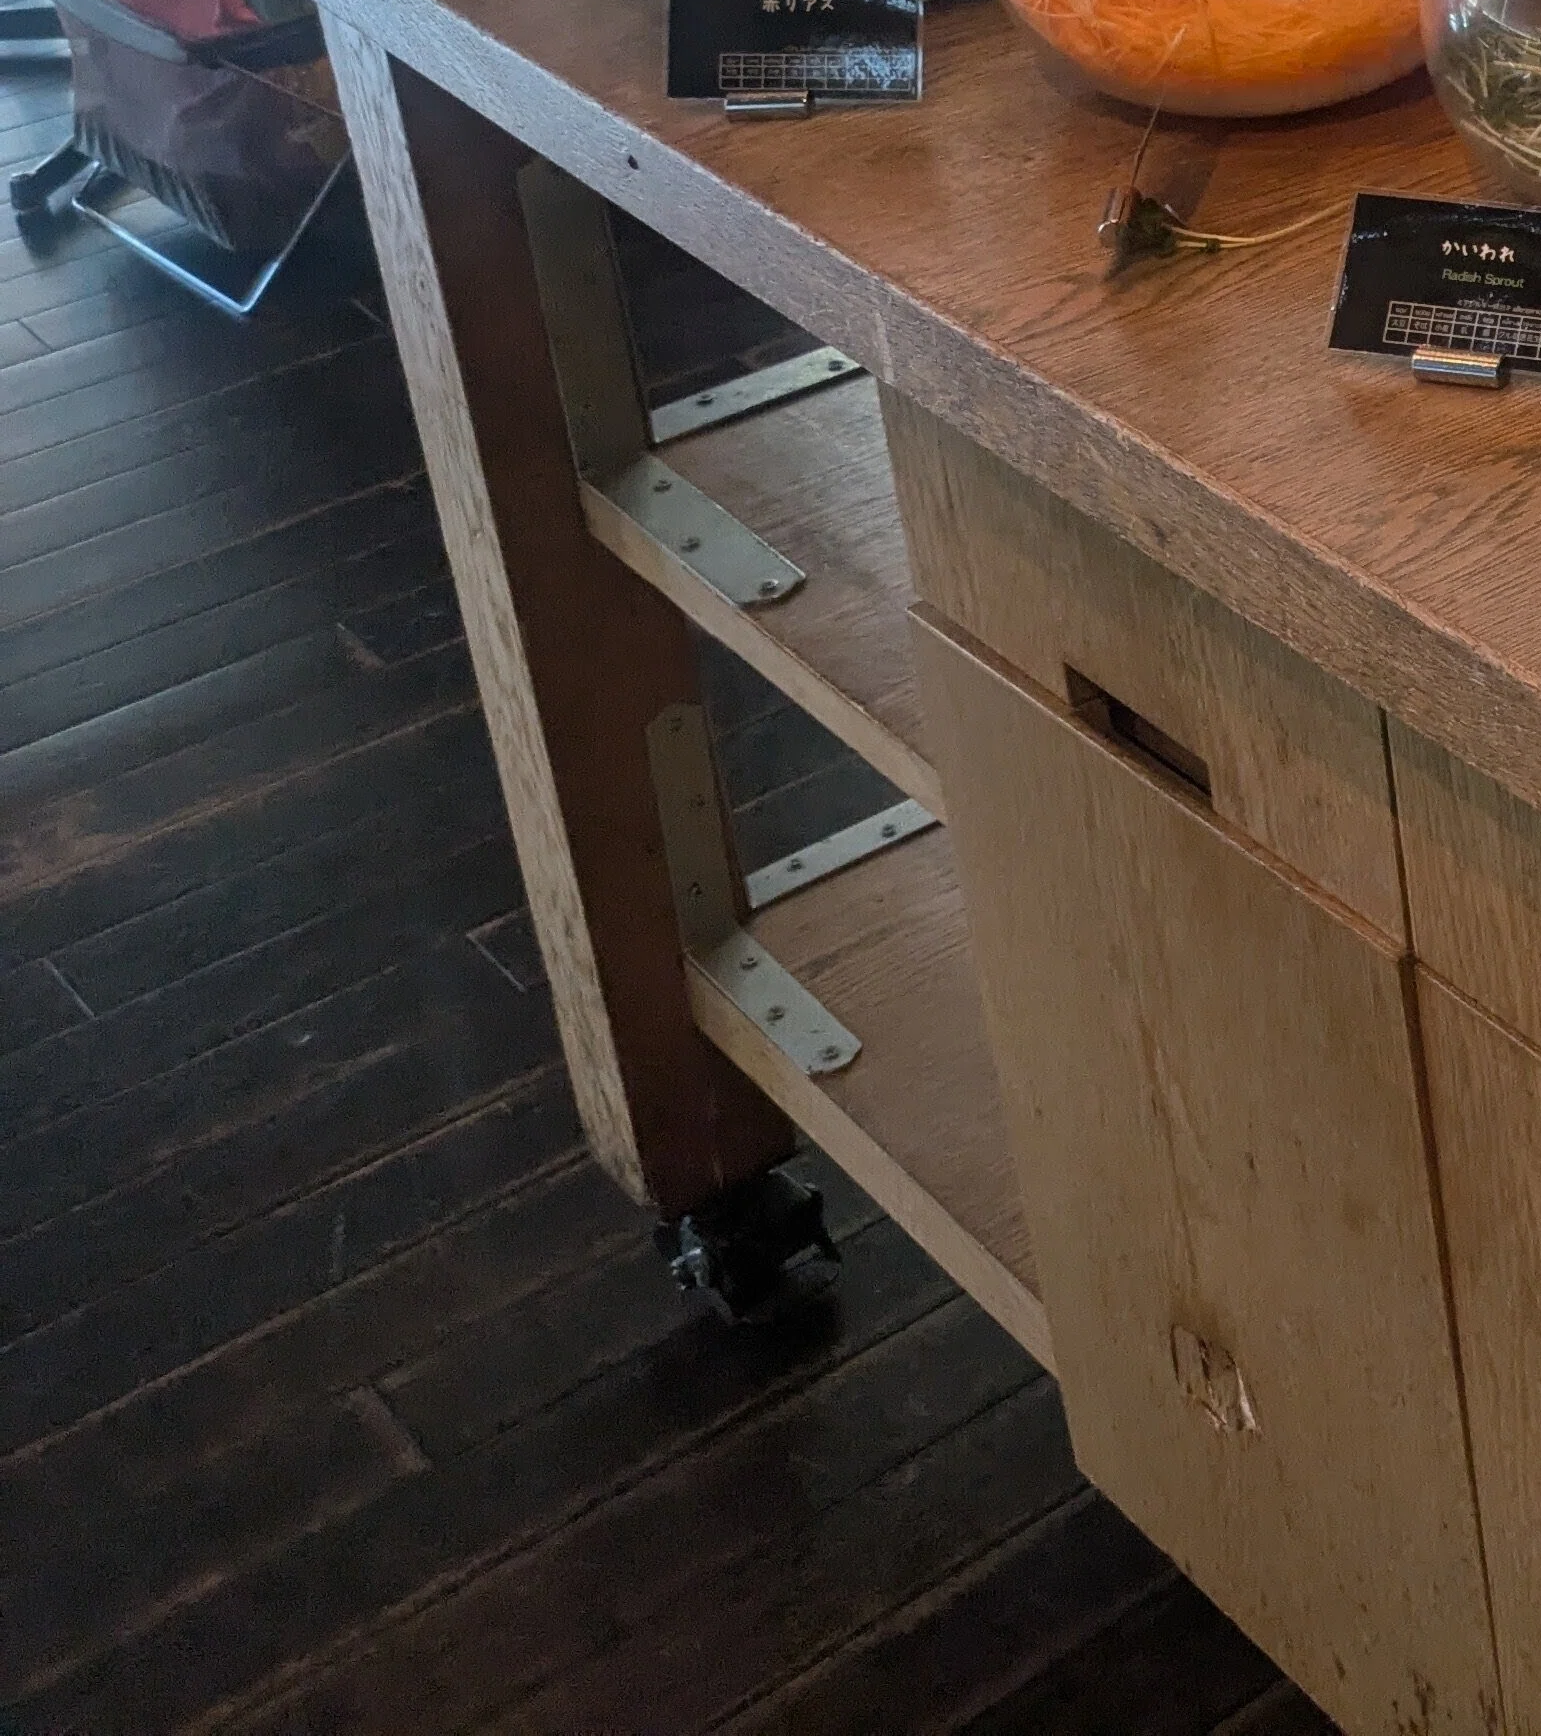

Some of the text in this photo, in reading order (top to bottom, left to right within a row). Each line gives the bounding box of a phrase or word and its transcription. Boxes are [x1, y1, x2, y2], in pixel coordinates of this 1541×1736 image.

[1441, 240, 1515, 263] かいわれ
[1441, 268, 1525, 289] Radish Sprout
